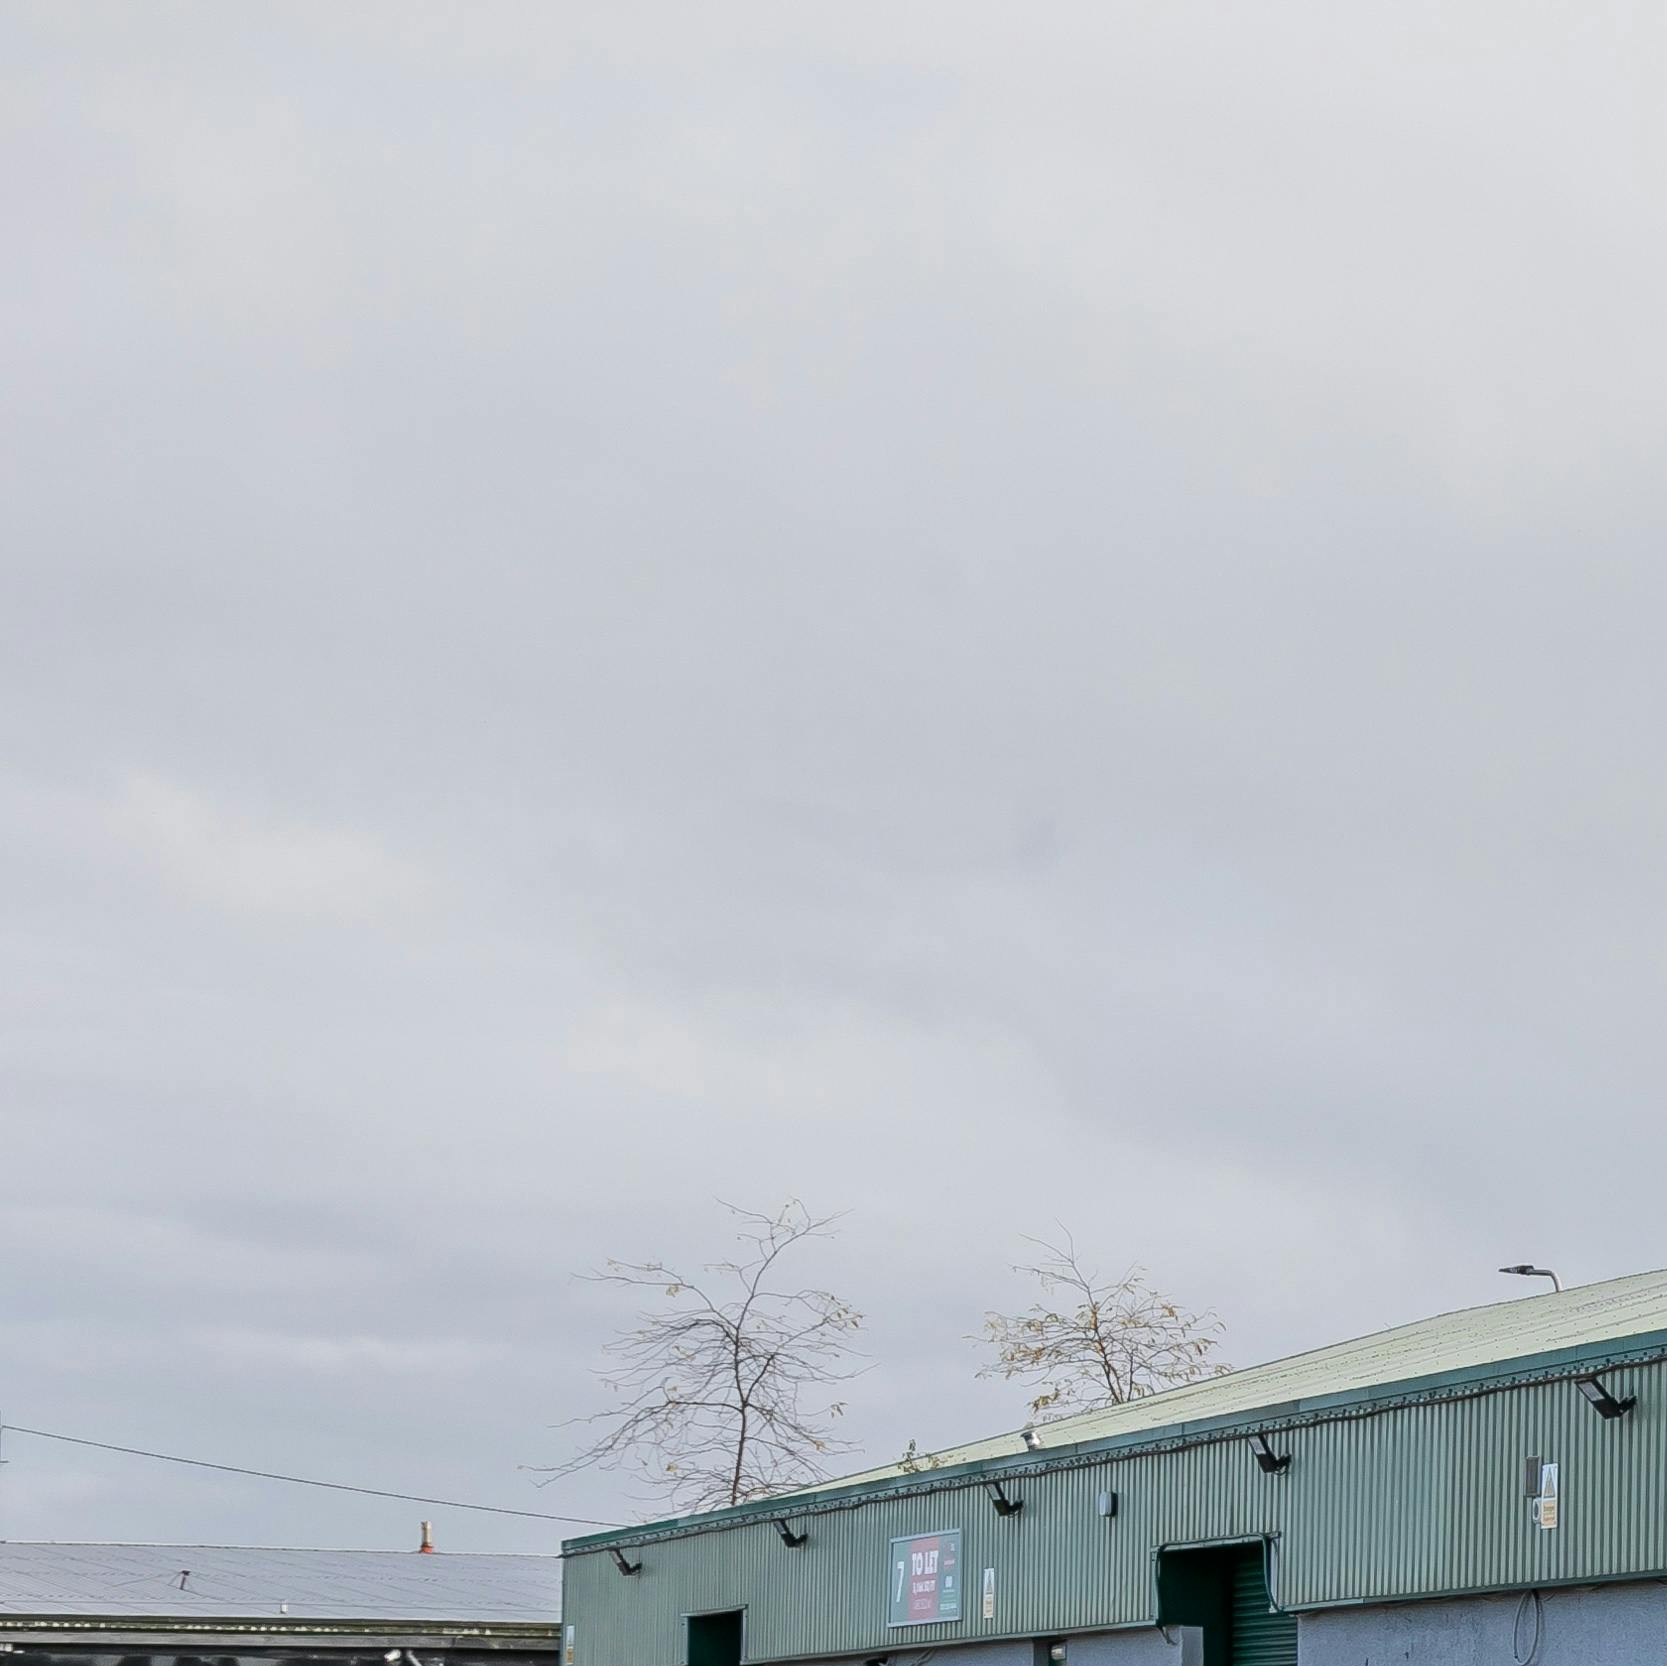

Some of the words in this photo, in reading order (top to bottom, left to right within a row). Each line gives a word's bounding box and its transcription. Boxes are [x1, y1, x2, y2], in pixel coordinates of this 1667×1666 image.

[911, 1551, 923, 1576] TO
[924, 1550, 939, 1575] LET
[896, 1561, 905, 1603] 7
